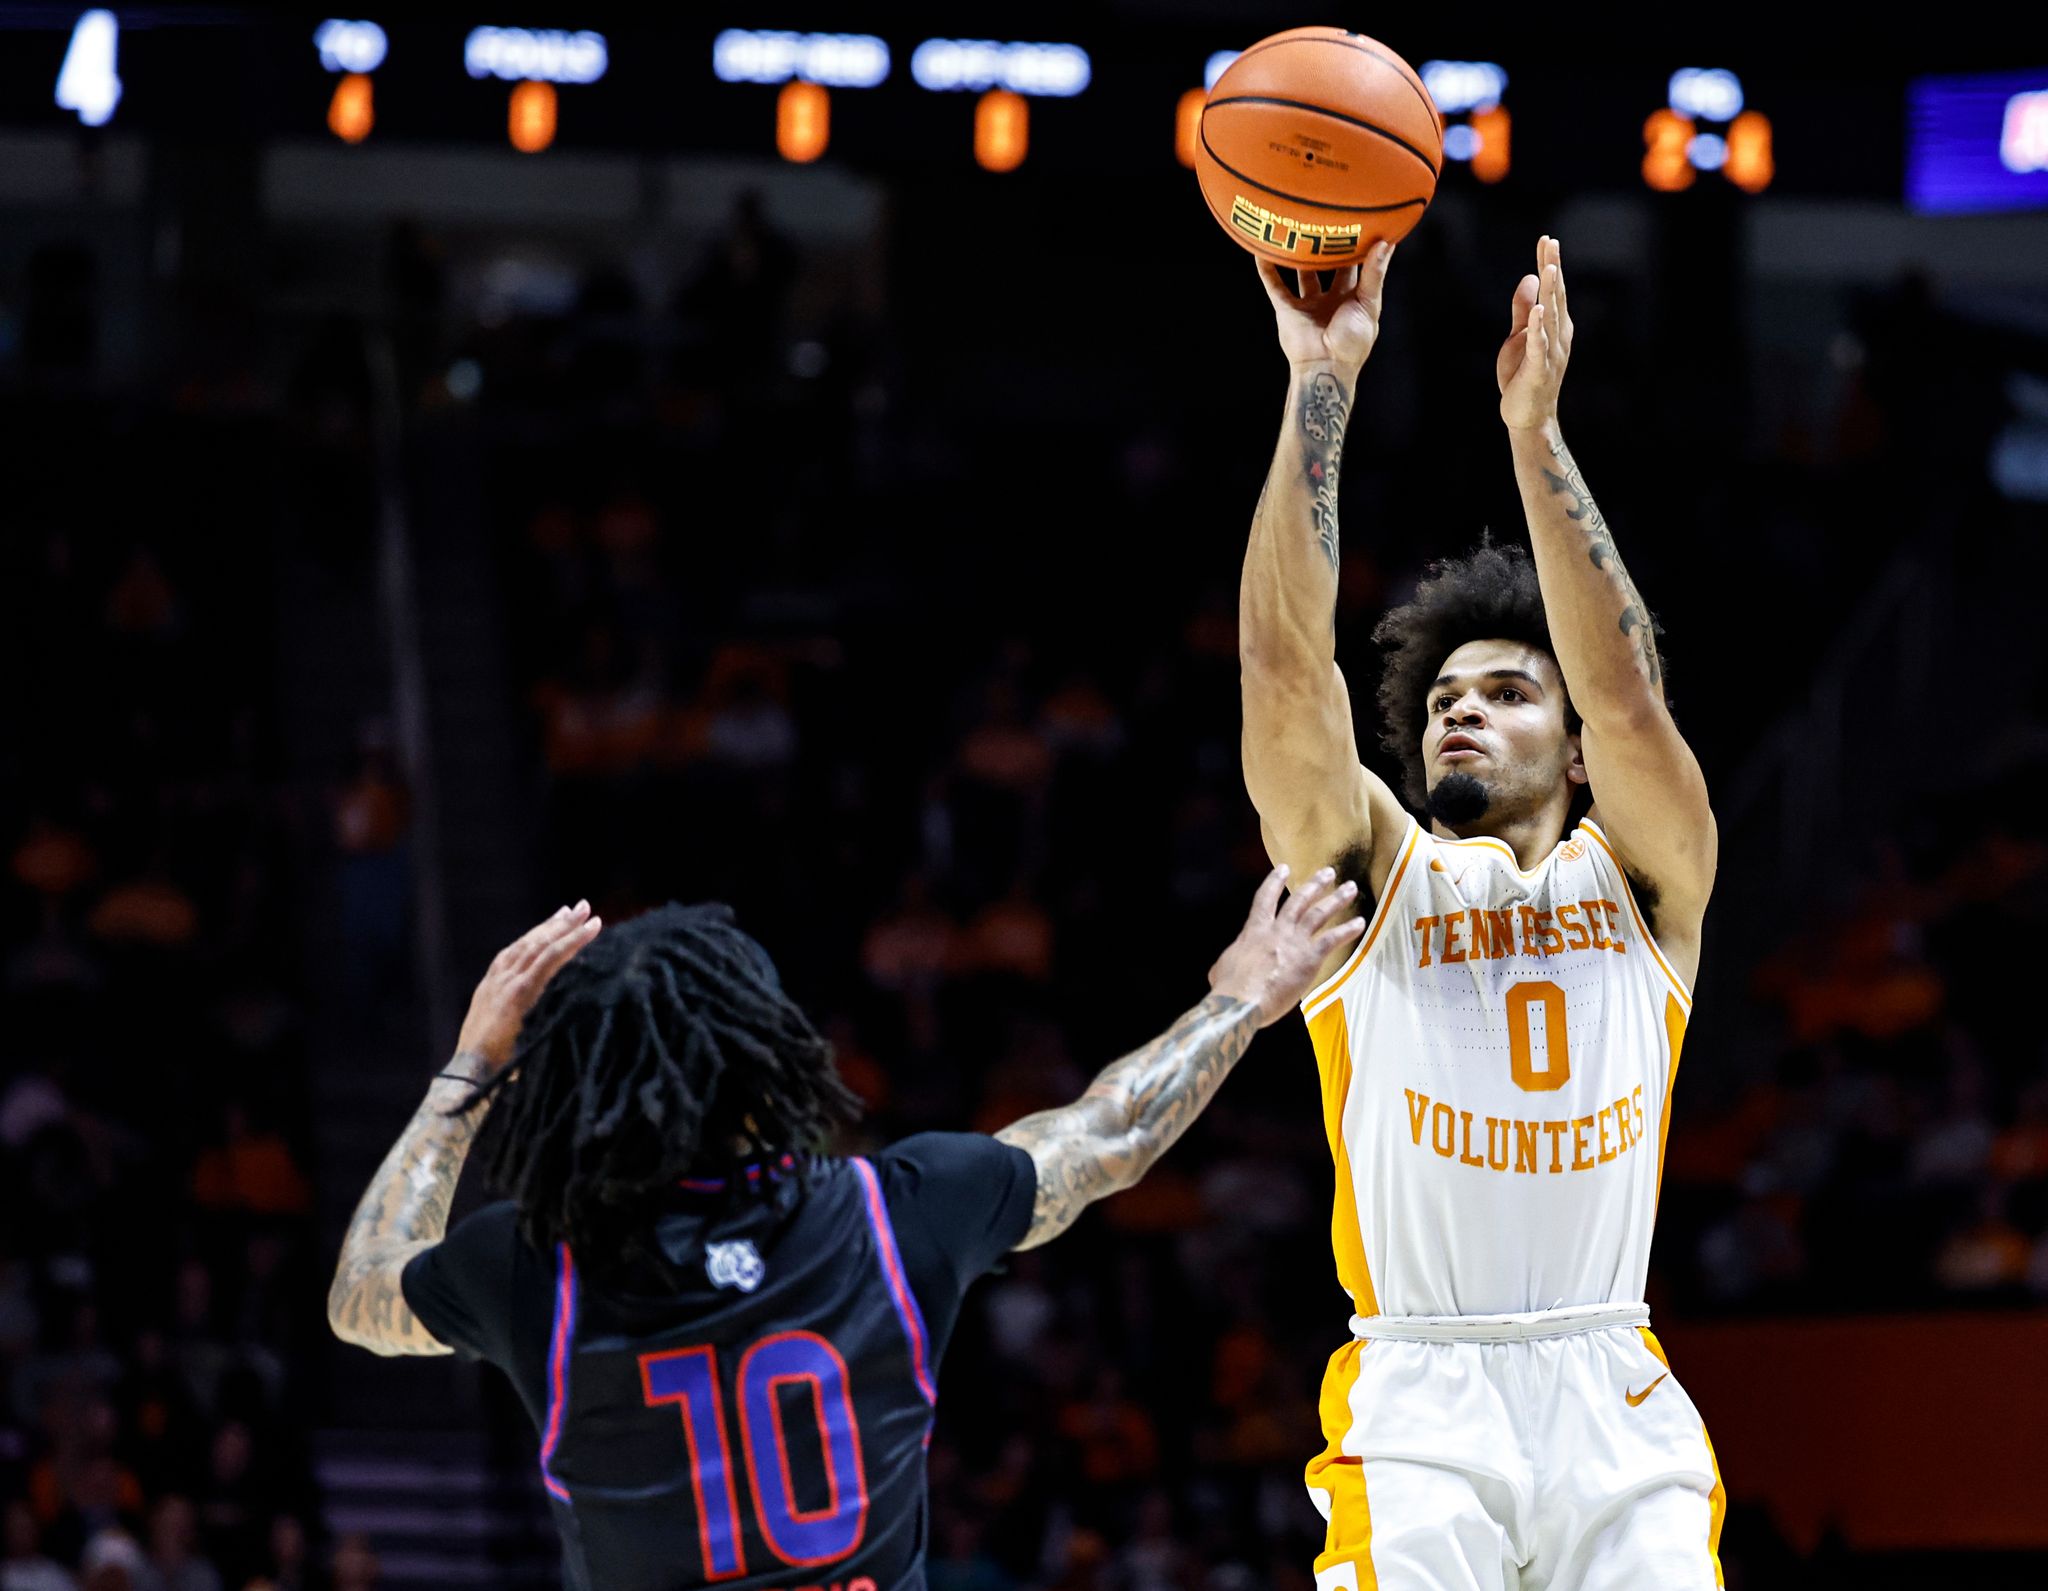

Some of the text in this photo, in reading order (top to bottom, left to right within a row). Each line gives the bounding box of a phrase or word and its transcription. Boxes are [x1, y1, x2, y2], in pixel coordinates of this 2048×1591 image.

[1230, 200, 1361, 256] ELITE
[1413, 898, 1626, 968] TENNESSEE
[1505, 981, 1570, 1092] 0
[1404, 1084, 1643, 1174] VOLUNTEERS
[637, 1330, 870, 1582] 10
